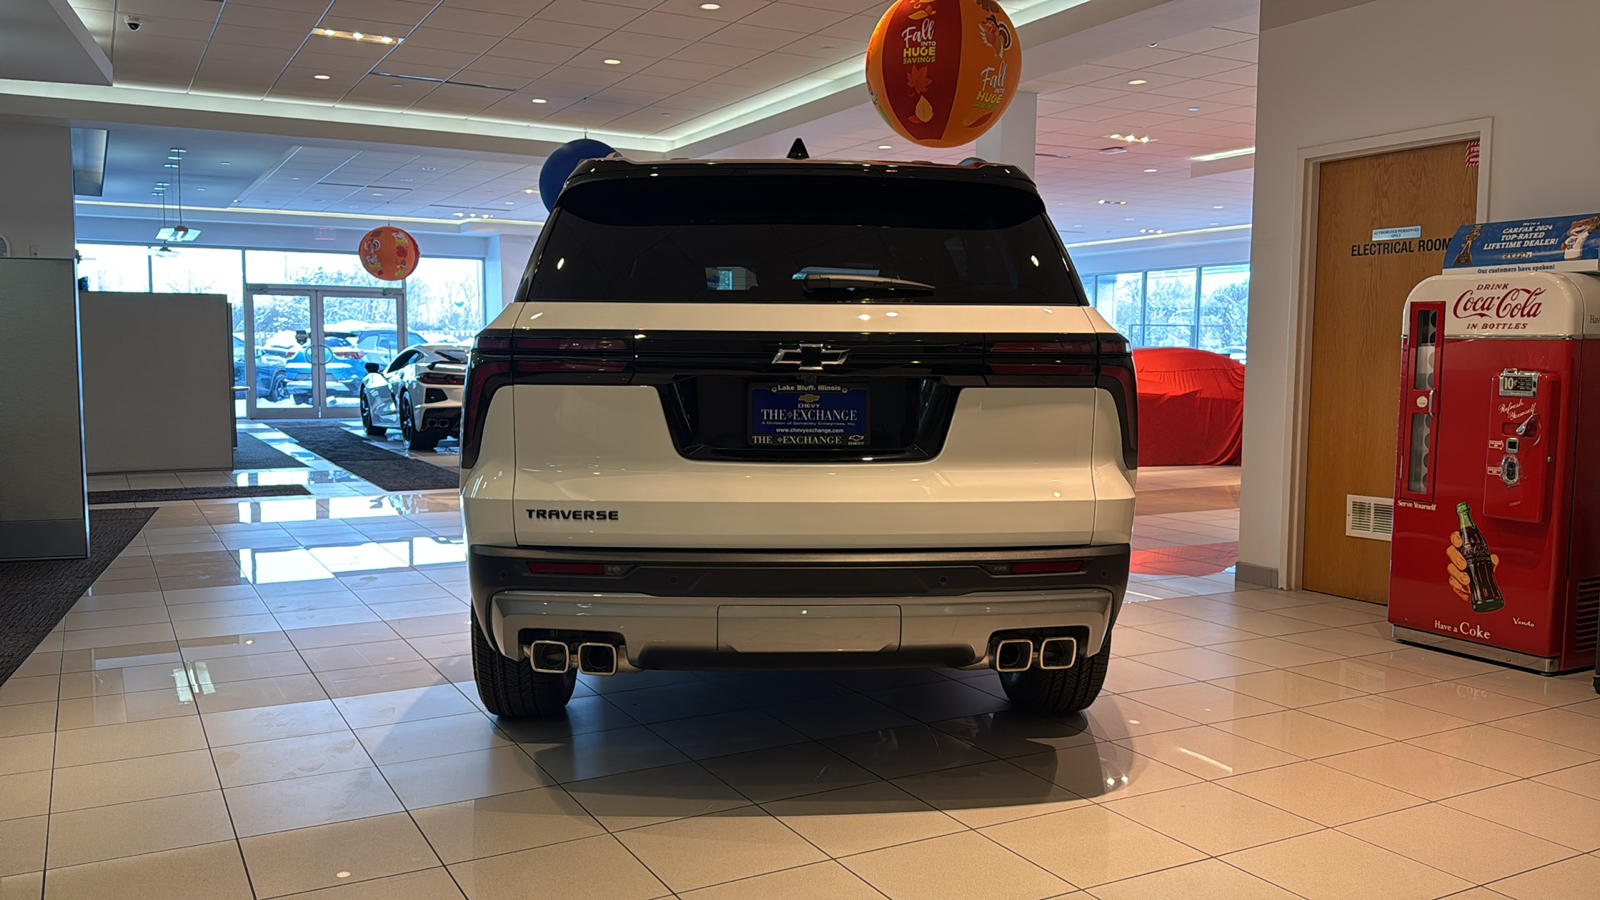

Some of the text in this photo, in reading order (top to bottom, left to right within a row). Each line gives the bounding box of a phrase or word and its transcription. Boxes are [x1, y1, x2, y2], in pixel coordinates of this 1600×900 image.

[901, 18, 934, 48] Fall
[903, 47, 936, 58] HUGE
[980, 61, 1008, 92] Fall
[976, 91, 1002, 103] HUGE
[1501, 232, 1545, 241] TOP-RATED
[1351, 241, 1414, 256] ELECTRICAL
[1483, 241, 1521, 250] LIFETIME
[1523, 238, 1559, 248] DEALER!
[1453, 287, 1546, 319] Coca-Cola
[1590, 315, 1600, 324] Ha
[761, 409, 857, 421] THE EXCHANGE
[752, 436, 842, 444] THE EXCHANGE
[1414, 502, 1437, 511] Yourself
[526, 509, 619, 520] TRAVERSE
[1513, 617, 1535, 627] Vendo
[1435, 620, 1451, 632] Have
[1460, 621, 1491, 640] Coke
